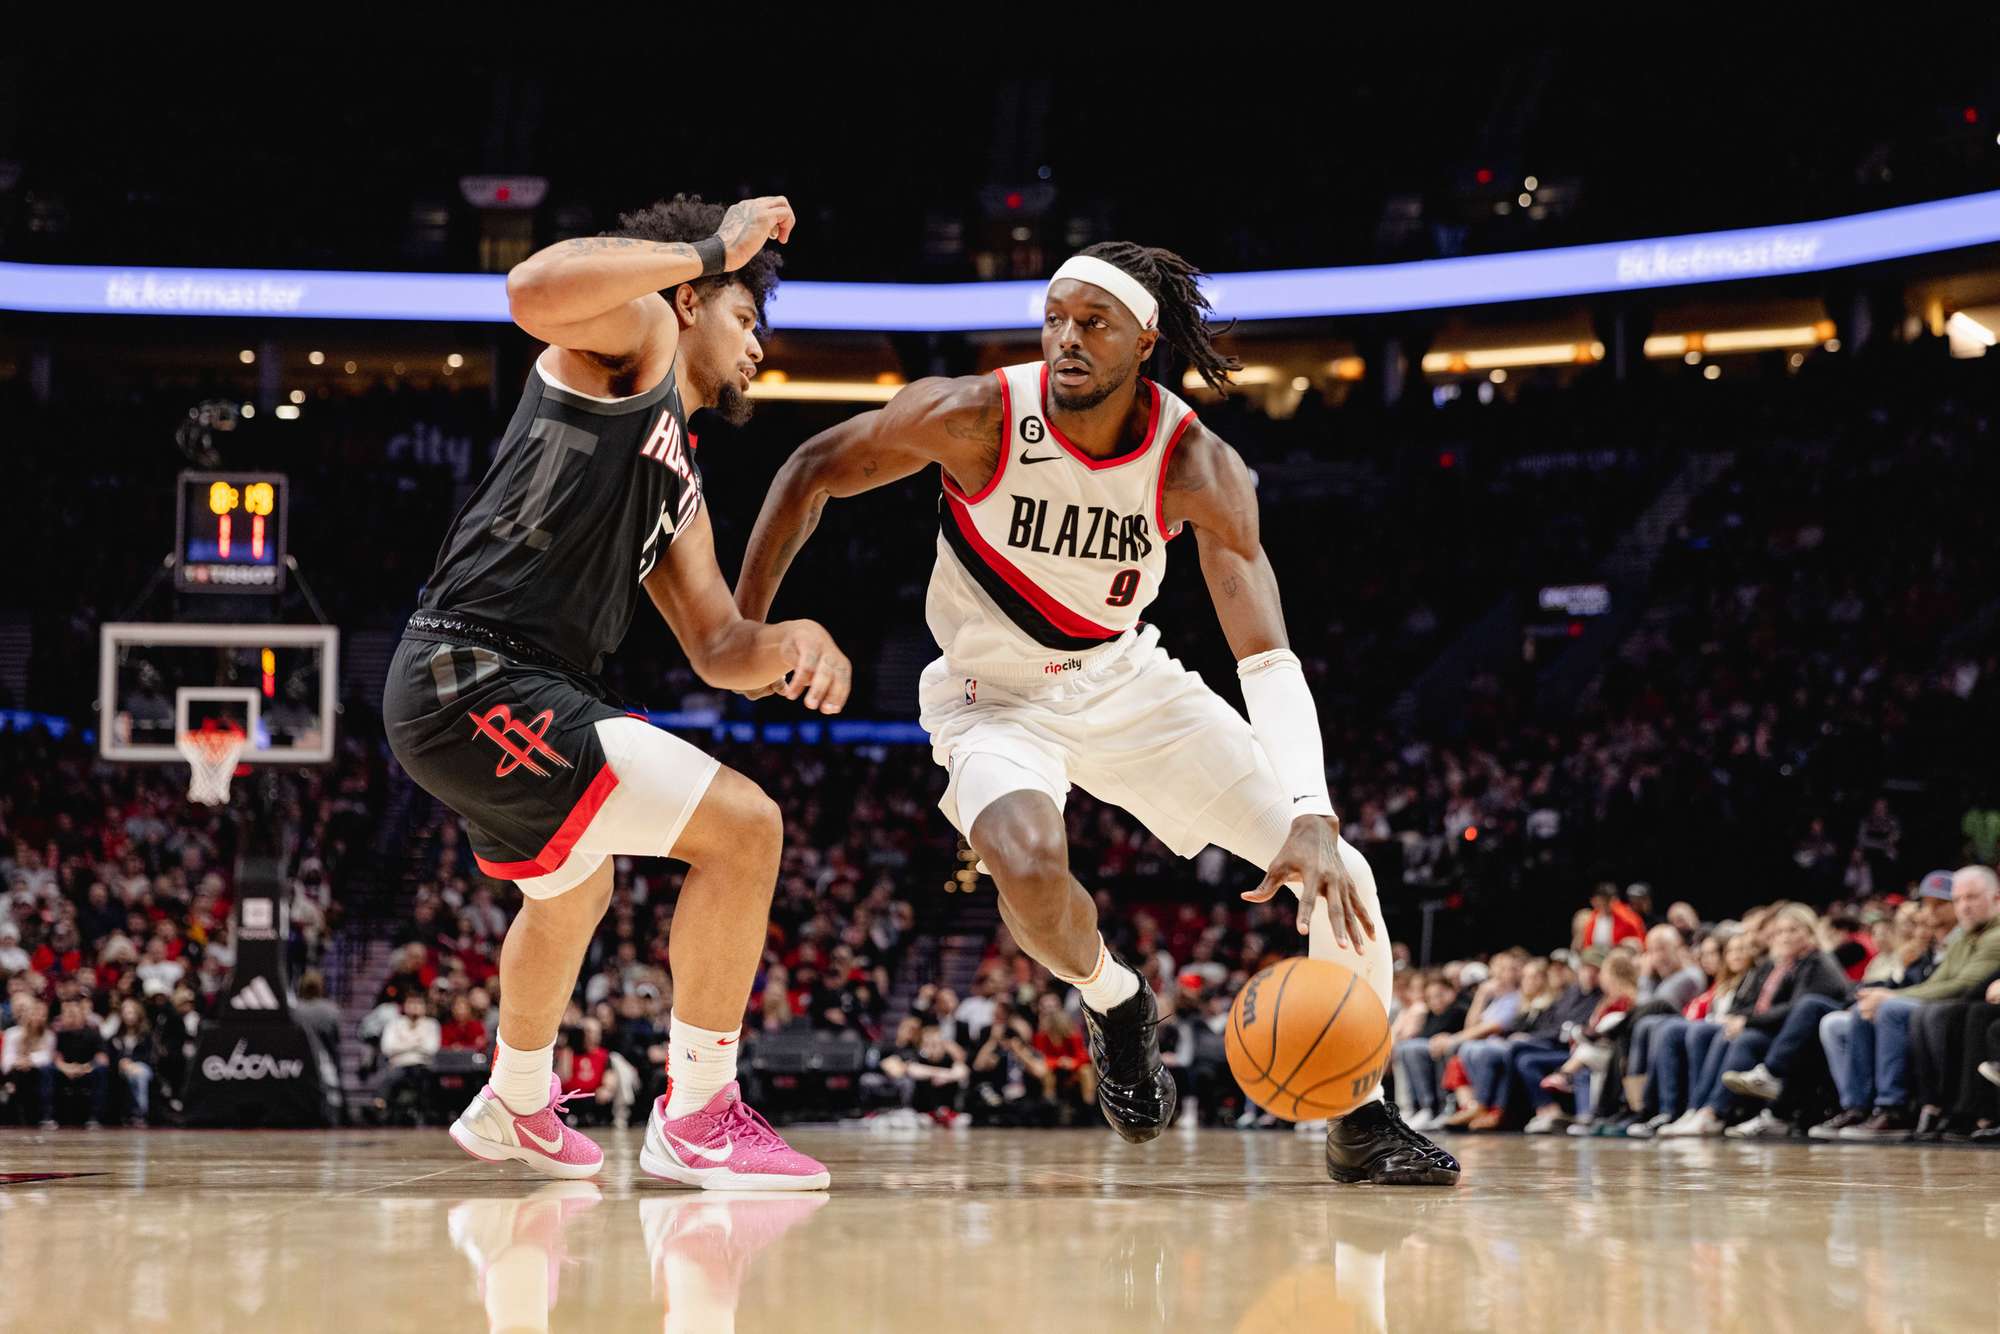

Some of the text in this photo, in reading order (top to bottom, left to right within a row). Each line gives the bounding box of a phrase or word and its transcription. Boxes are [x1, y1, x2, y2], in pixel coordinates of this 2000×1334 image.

[1616, 236, 1821, 283] ticketmaster
[106, 272, 304, 311] ticketmaster
[1025, 419, 1039, 441] 6
[1008, 494, 1153, 562] BLAZERS
[1105, 569, 1141, 607] 9
[1044, 658, 1082, 676] ripcity
